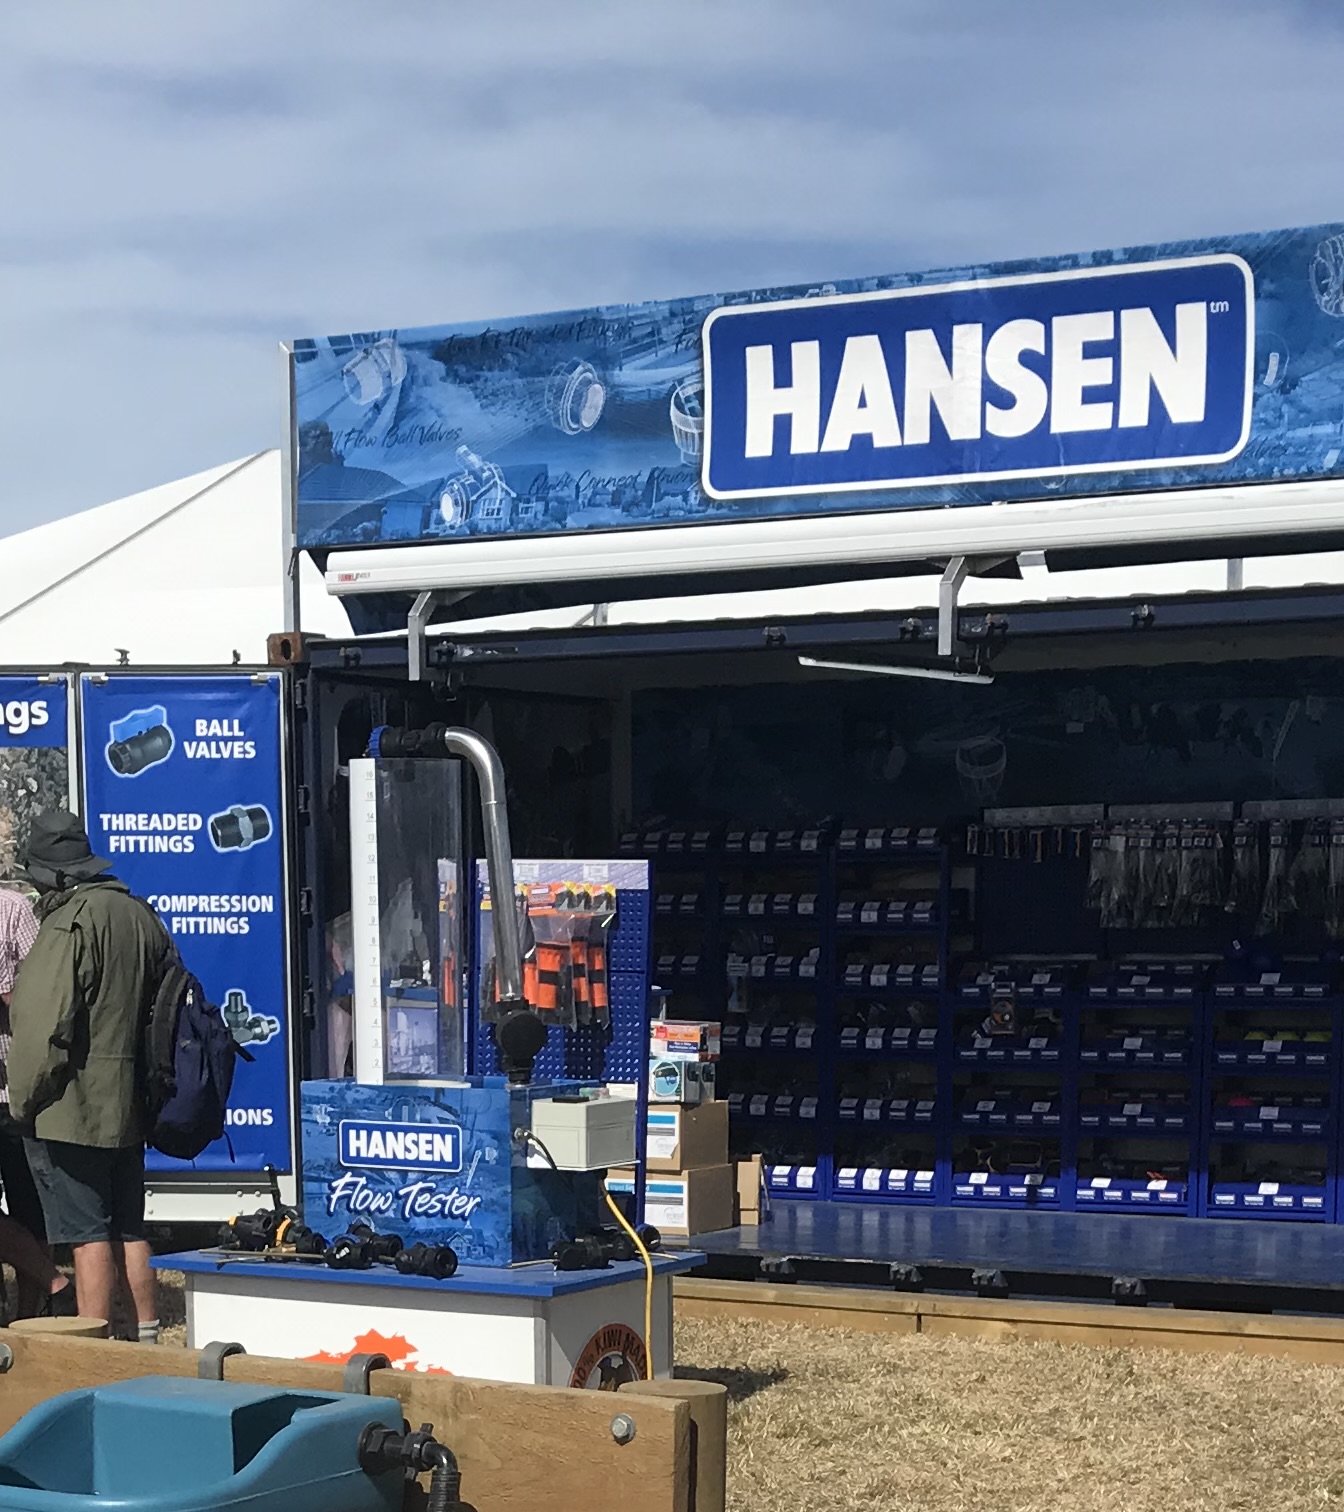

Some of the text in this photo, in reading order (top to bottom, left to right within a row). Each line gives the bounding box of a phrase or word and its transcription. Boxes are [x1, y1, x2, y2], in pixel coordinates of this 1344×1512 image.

[745, 301, 1208, 458] HANSEN
[345, 420, 462, 450] Flow Ball Valves
[195, 719, 244, 737] BALL
[183, 740, 256, 759] VALVES
[100, 814, 202, 831] THREADED
[109, 835, 195, 853] FITTINGS
[147, 895, 274, 913] COMPRESSION
[171, 917, 249, 934] FITTINGS
[225, 1108, 274, 1126] IONS
[348, 1128, 453, 1162] HANSEN
[328, 1171, 482, 1219] Flow Tester
[595, 1329, 622, 1355] KIWI
